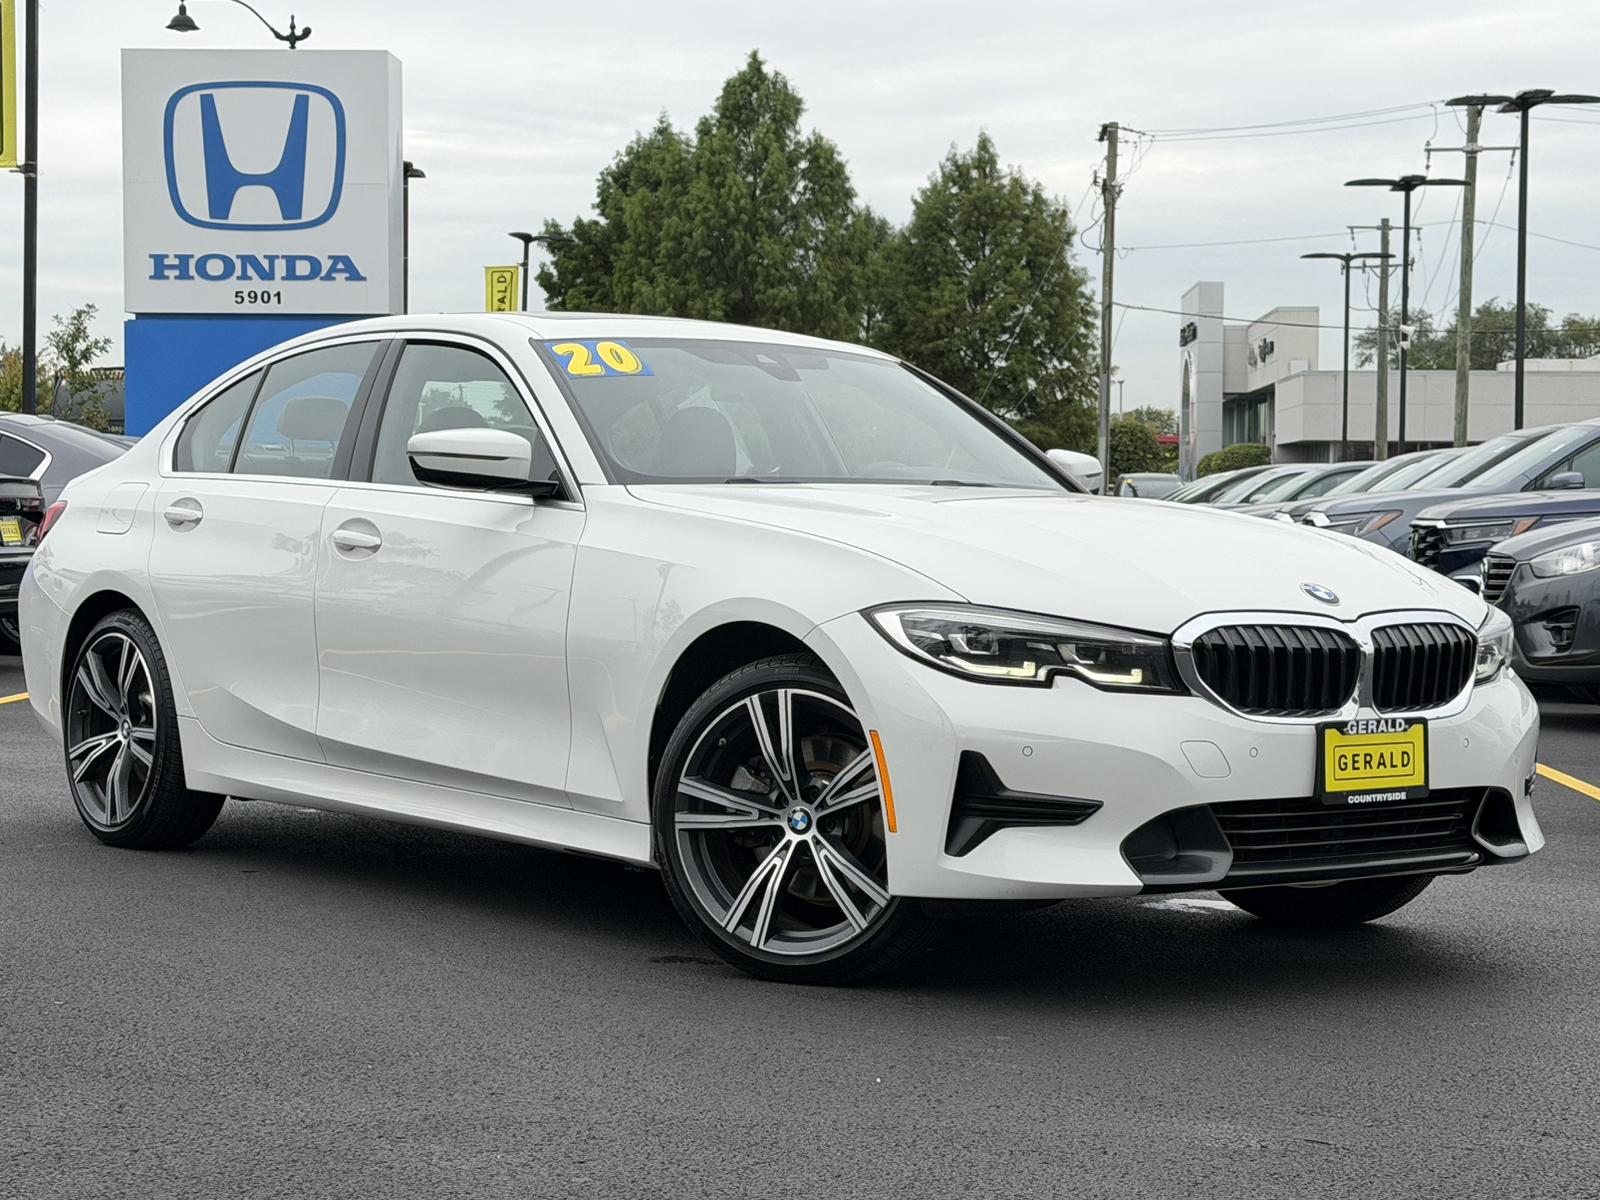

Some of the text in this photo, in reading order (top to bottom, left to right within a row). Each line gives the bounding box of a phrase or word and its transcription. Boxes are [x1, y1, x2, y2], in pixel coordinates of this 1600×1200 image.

[148, 253, 367, 281] HONDA
[234, 290, 282, 305] 5901
[552, 341, 644, 377] 20
[1347, 719, 1405, 735] GERALD
[1337, 751, 1411, 772] GERALD
[1347, 791, 1407, 804] COUNTRYSIDE
